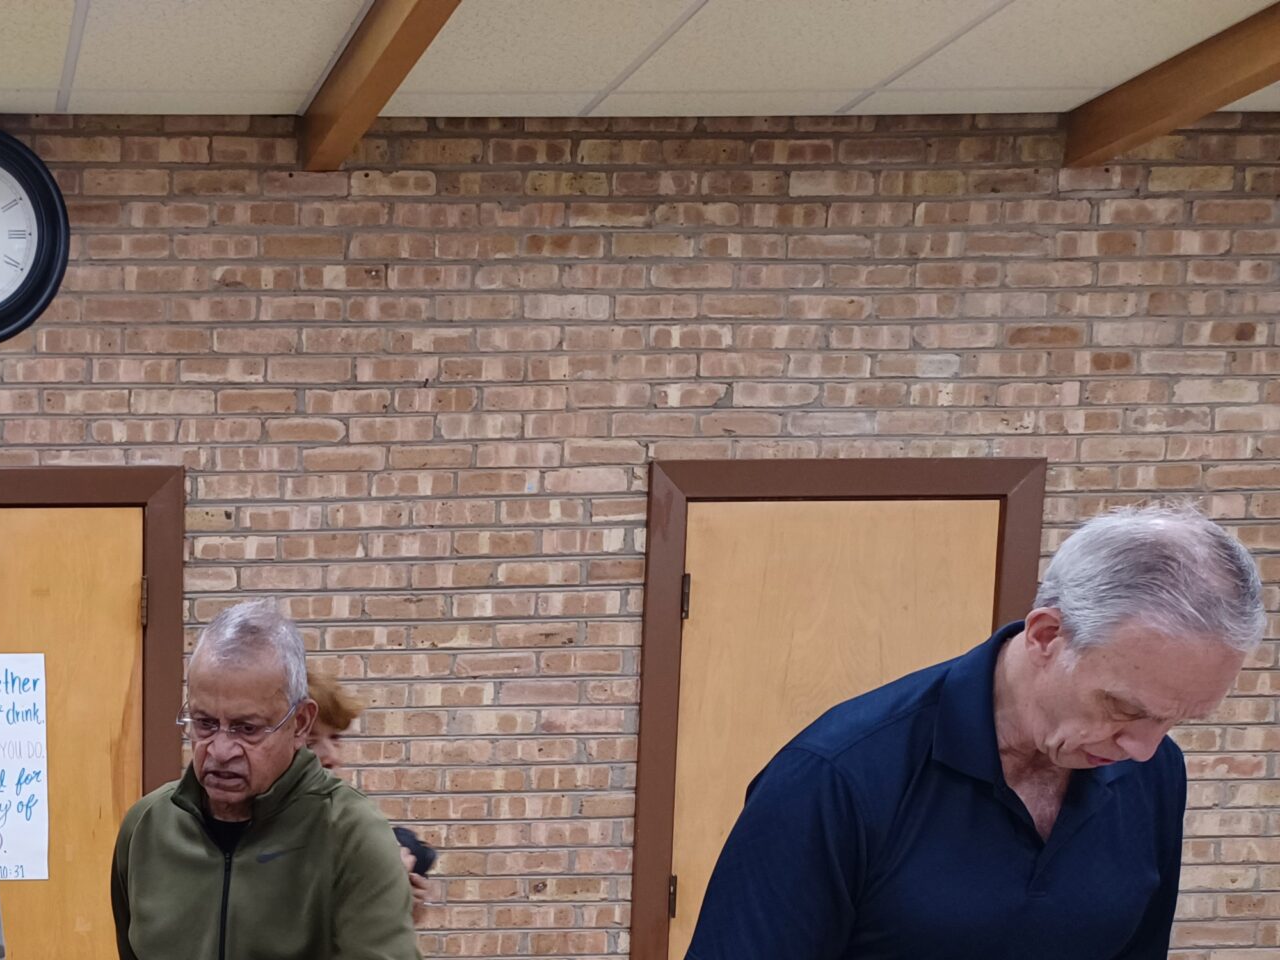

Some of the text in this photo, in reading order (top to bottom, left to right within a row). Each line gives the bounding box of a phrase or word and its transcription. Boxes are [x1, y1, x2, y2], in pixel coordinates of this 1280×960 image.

[0, 740, 23, 760] YOU
[16, 768, 42, 796] for
[17, 794, 39, 821] of
